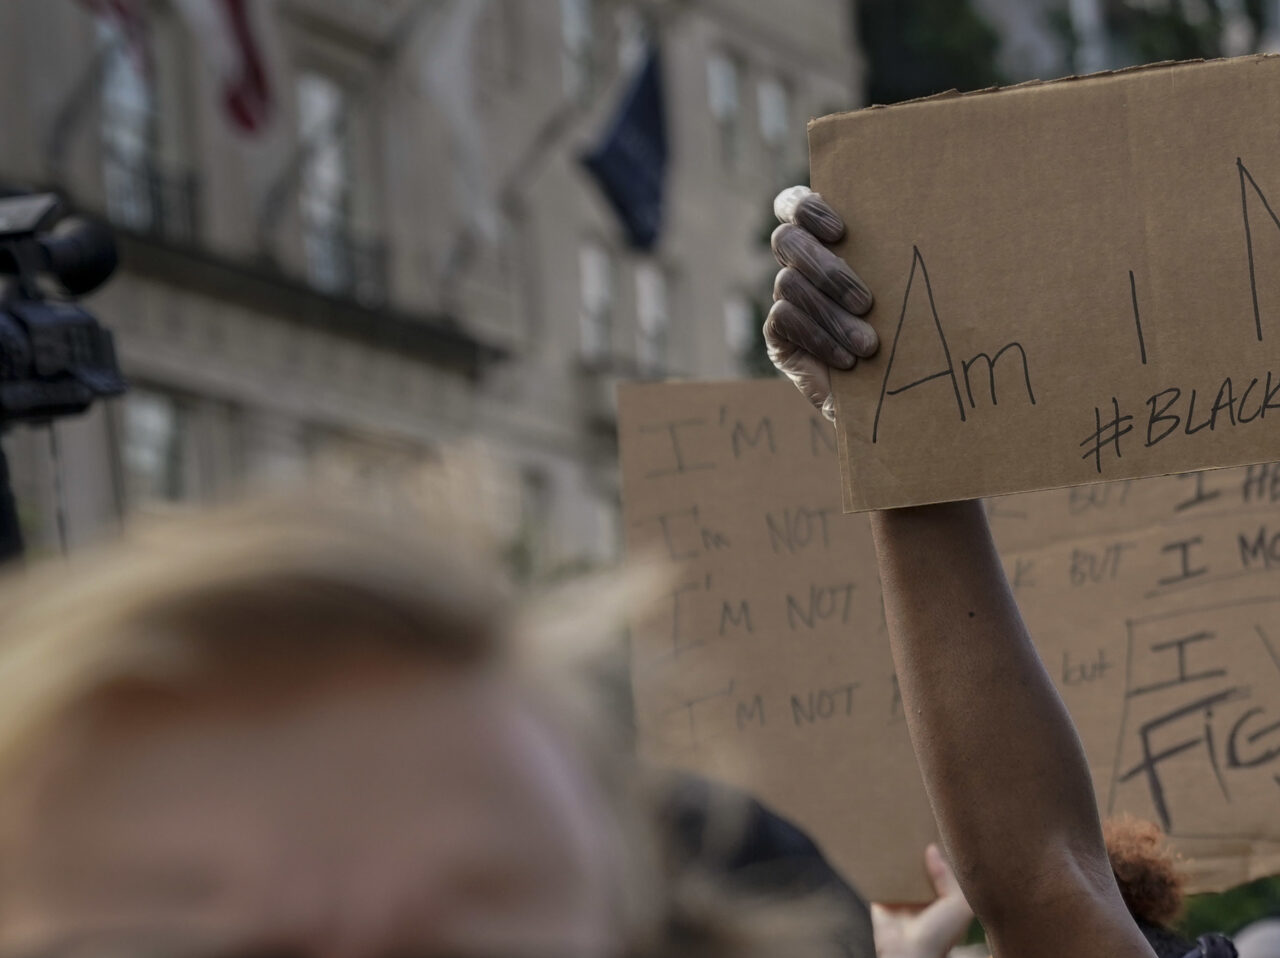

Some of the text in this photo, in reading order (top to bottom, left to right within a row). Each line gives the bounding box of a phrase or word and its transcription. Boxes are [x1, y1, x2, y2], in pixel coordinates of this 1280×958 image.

[870, 245, 1035, 443] Am
[1129, 270, 1147, 364] I
[766, 508, 838, 554] NOT
[1069, 543, 1137, 586] BUT
[786, 582, 857, 631] NOT
[790, 682, 860, 727] NOT
